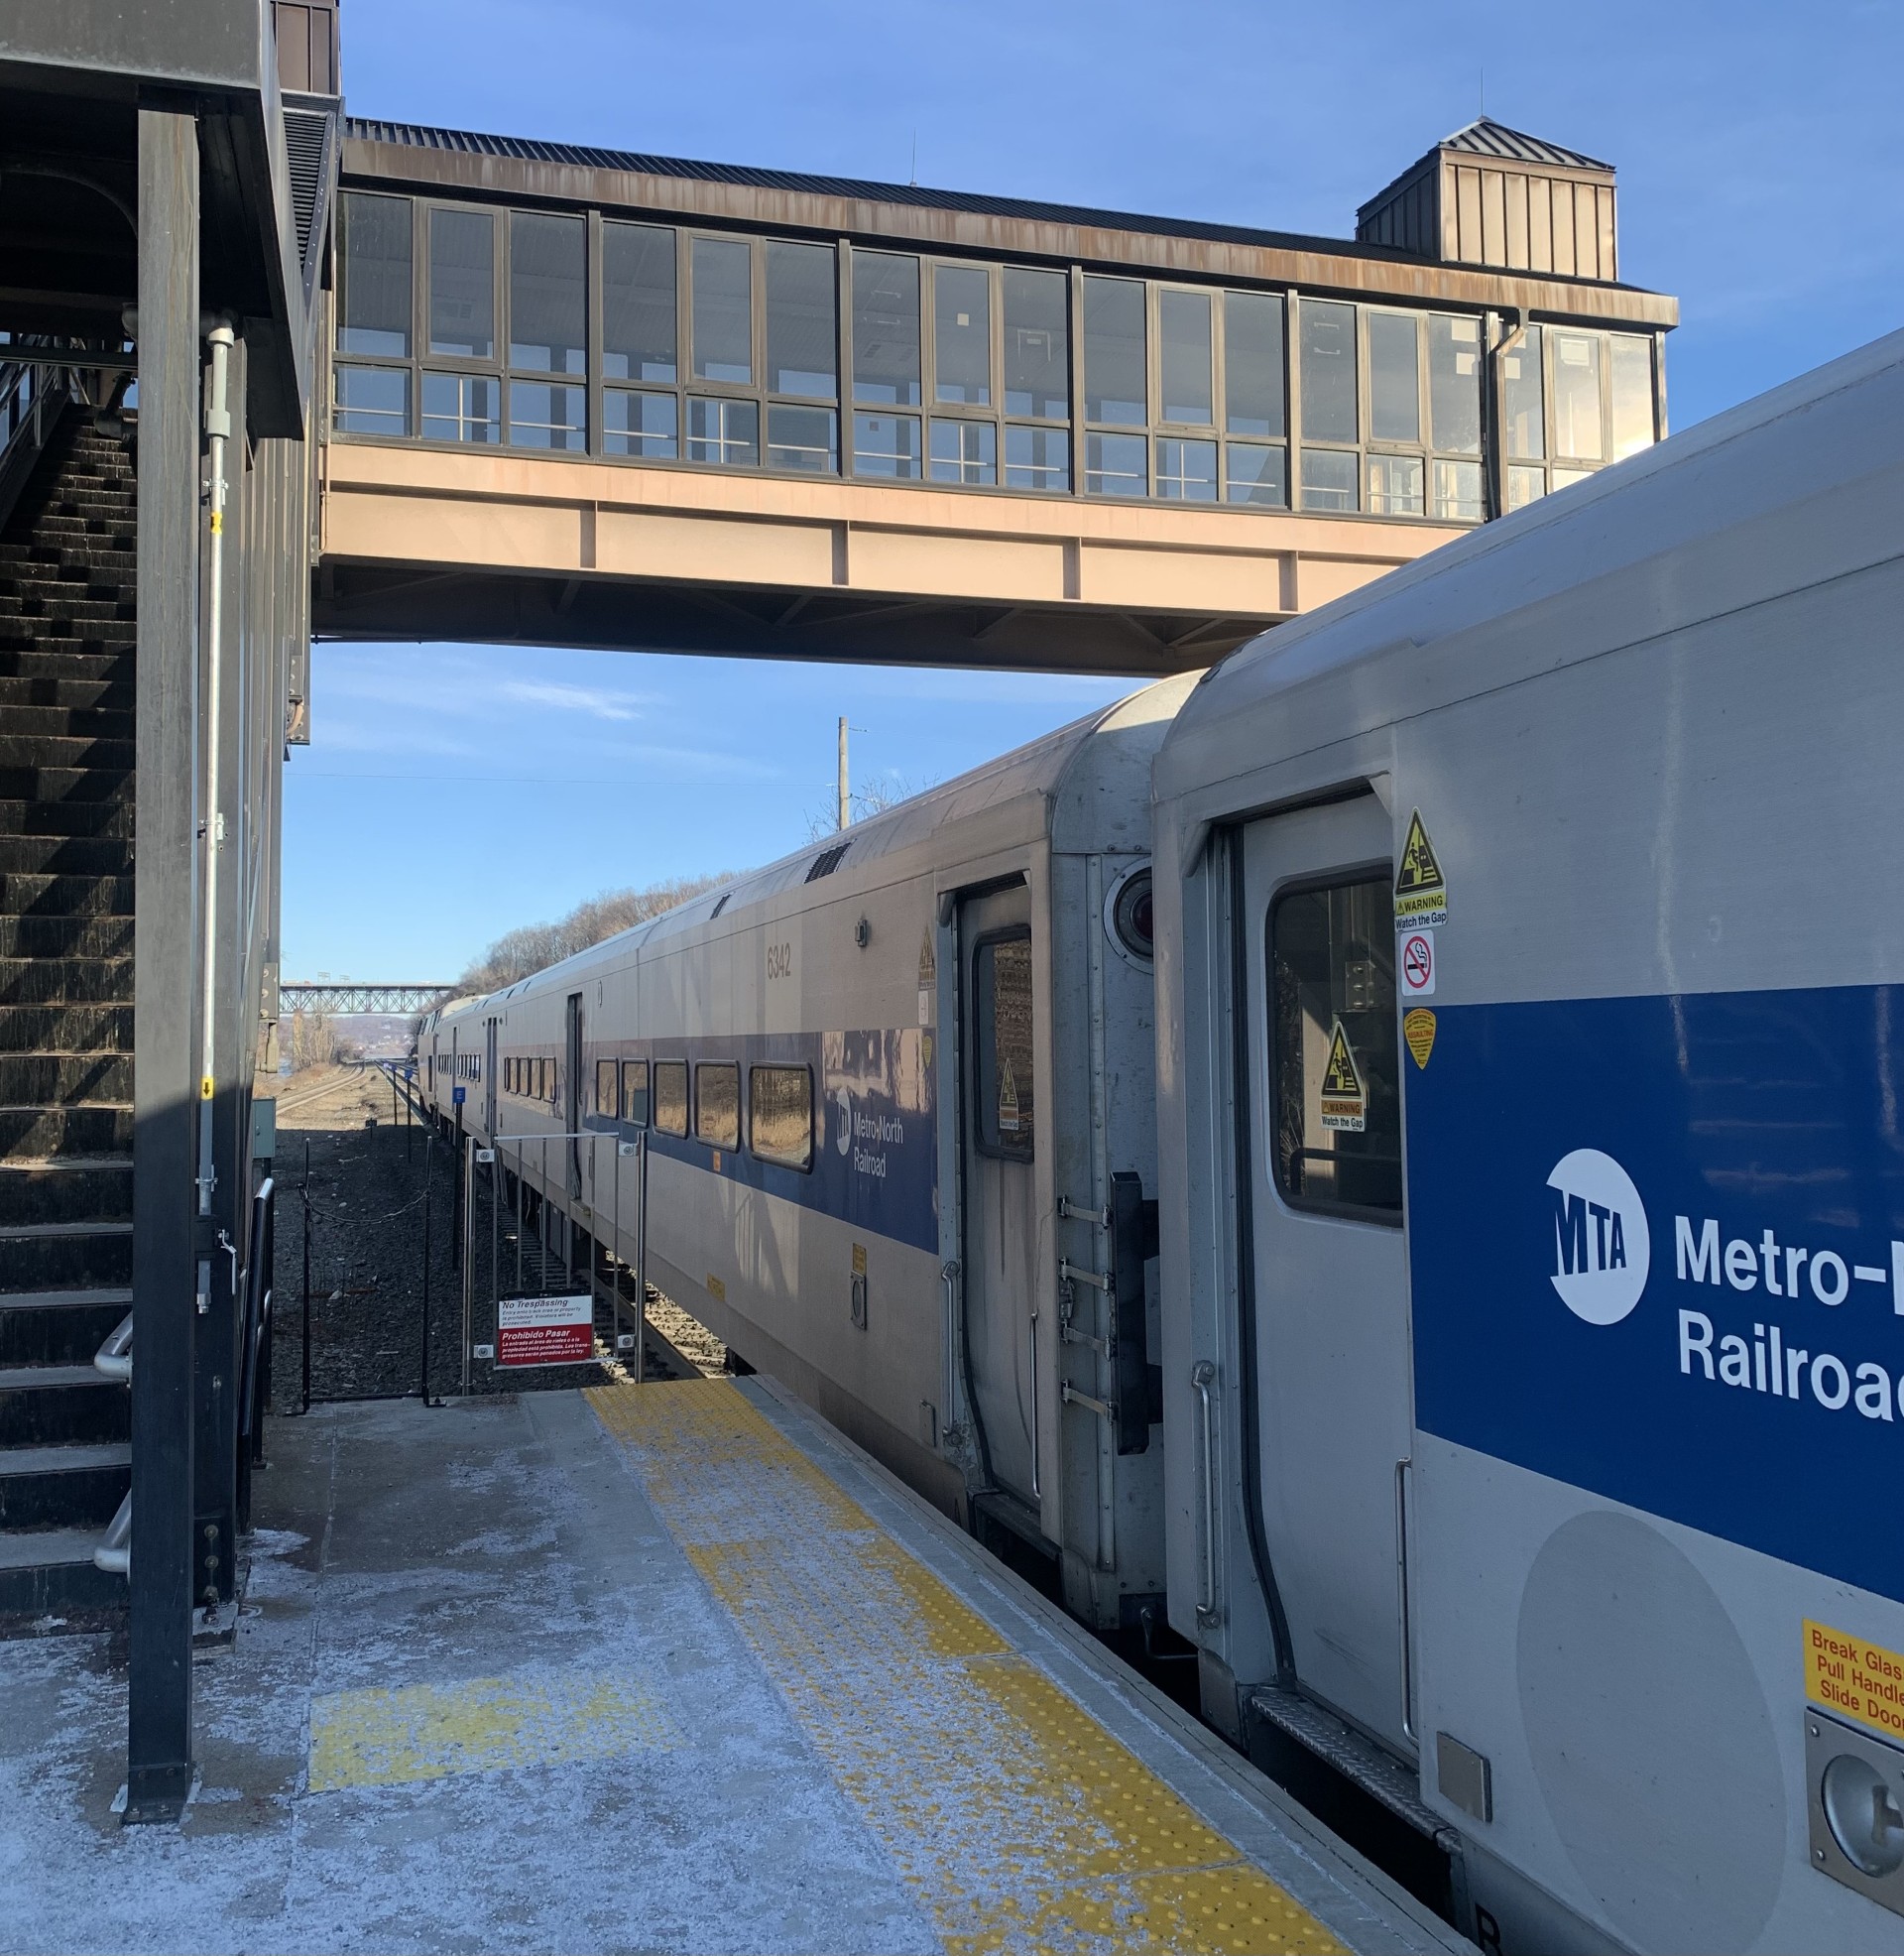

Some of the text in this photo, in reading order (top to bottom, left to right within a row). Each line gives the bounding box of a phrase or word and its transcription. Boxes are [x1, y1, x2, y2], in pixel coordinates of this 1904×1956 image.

[1404, 895, 1443, 913] WARNING
[1395, 912, 1447, 929] Watch the Gap
[768, 942, 791, 980] 6342
[1321, 1115, 1363, 1130] Watch the Gap
[1329, 1102, 1361, 1114] WARNING
[854, 1111, 903, 1144] Metro-North
[854, 1147, 887, 1177] Railroad
[1554, 1190, 1627, 1277] MTA
[518, 1298, 568, 1308] Trespassing
[502, 1329, 571, 1340] Prohibido Pasar
[1679, 1308, 1904, 1422] Railroa
[1812, 1629, 1904, 1681] Break Glas
[1818, 1653, 1844, 1681] Pull
[1821, 1679, 1904, 1731] Slide Doo
